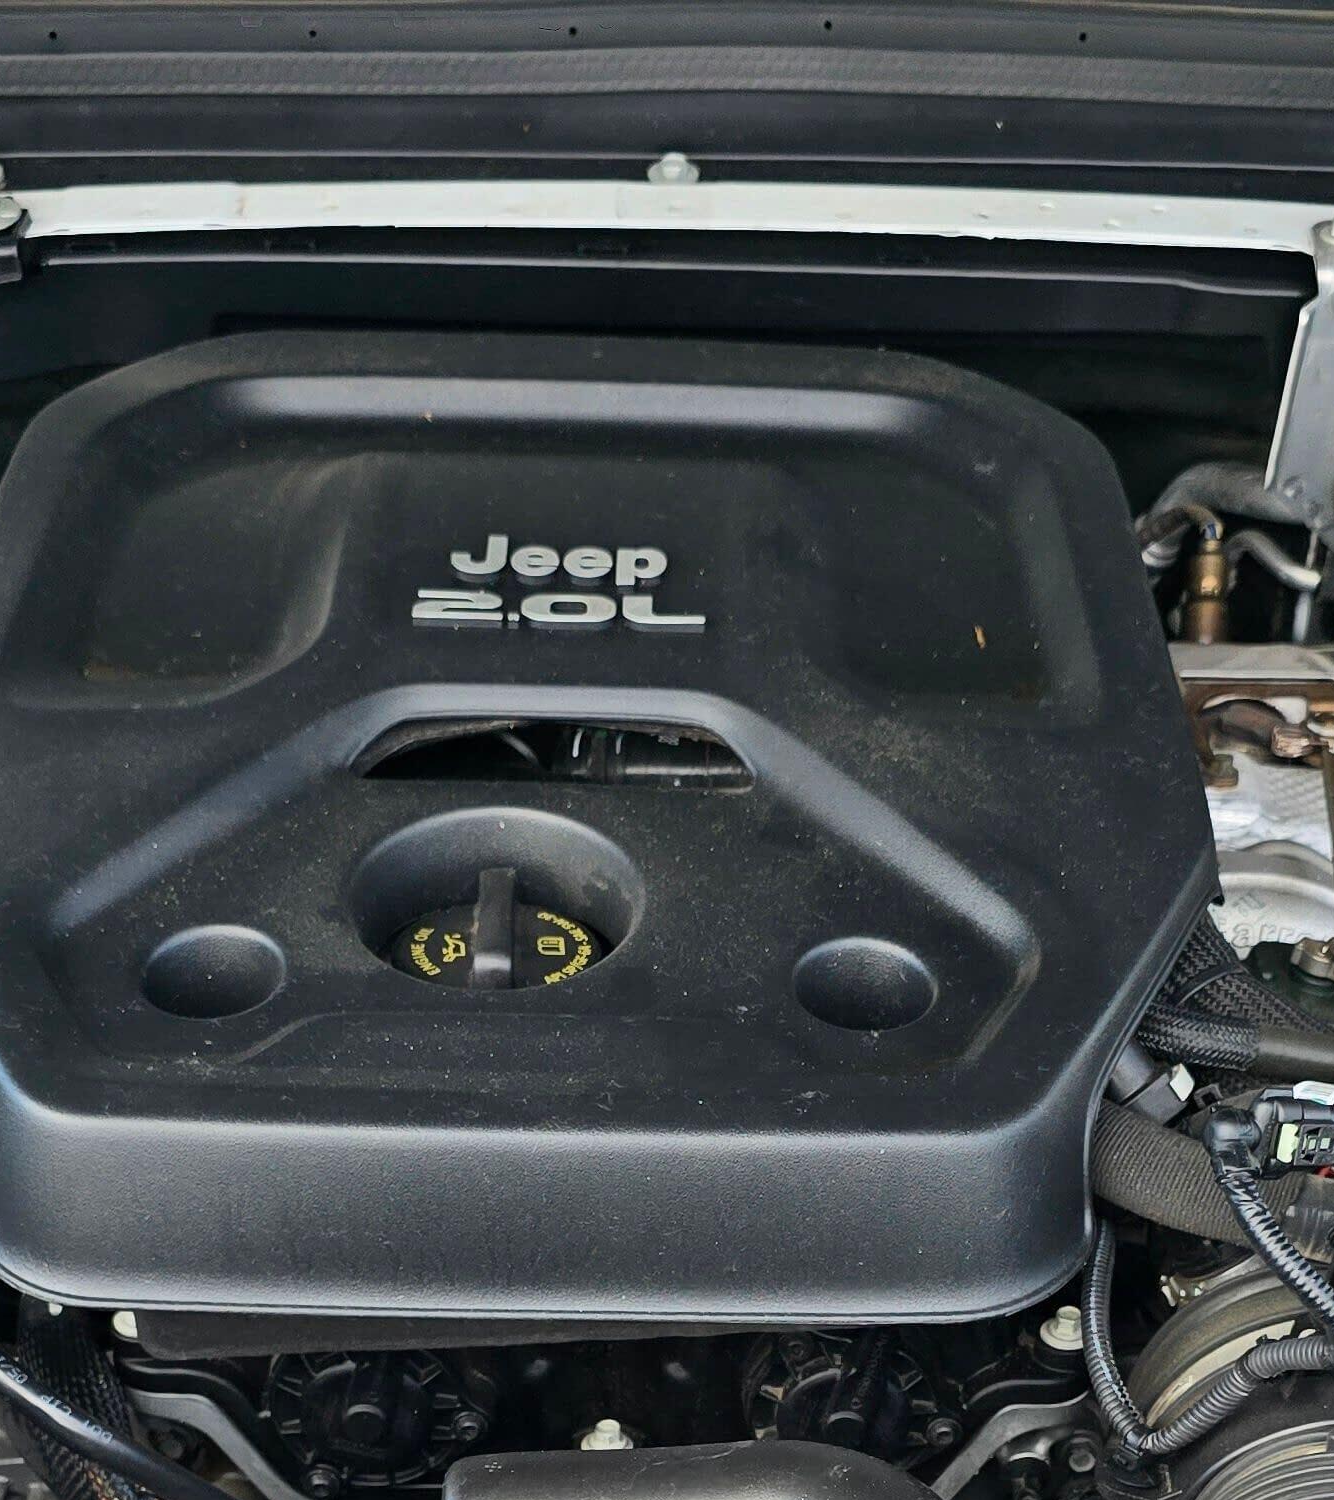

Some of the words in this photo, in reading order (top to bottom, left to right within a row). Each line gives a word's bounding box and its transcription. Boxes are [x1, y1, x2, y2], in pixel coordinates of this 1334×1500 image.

[450, 534, 667, 586] Jeep
[411, 588, 707, 628] 2.0L
[414, 928, 435, 942] OIL
[410, 943, 442, 976] ENGINE
